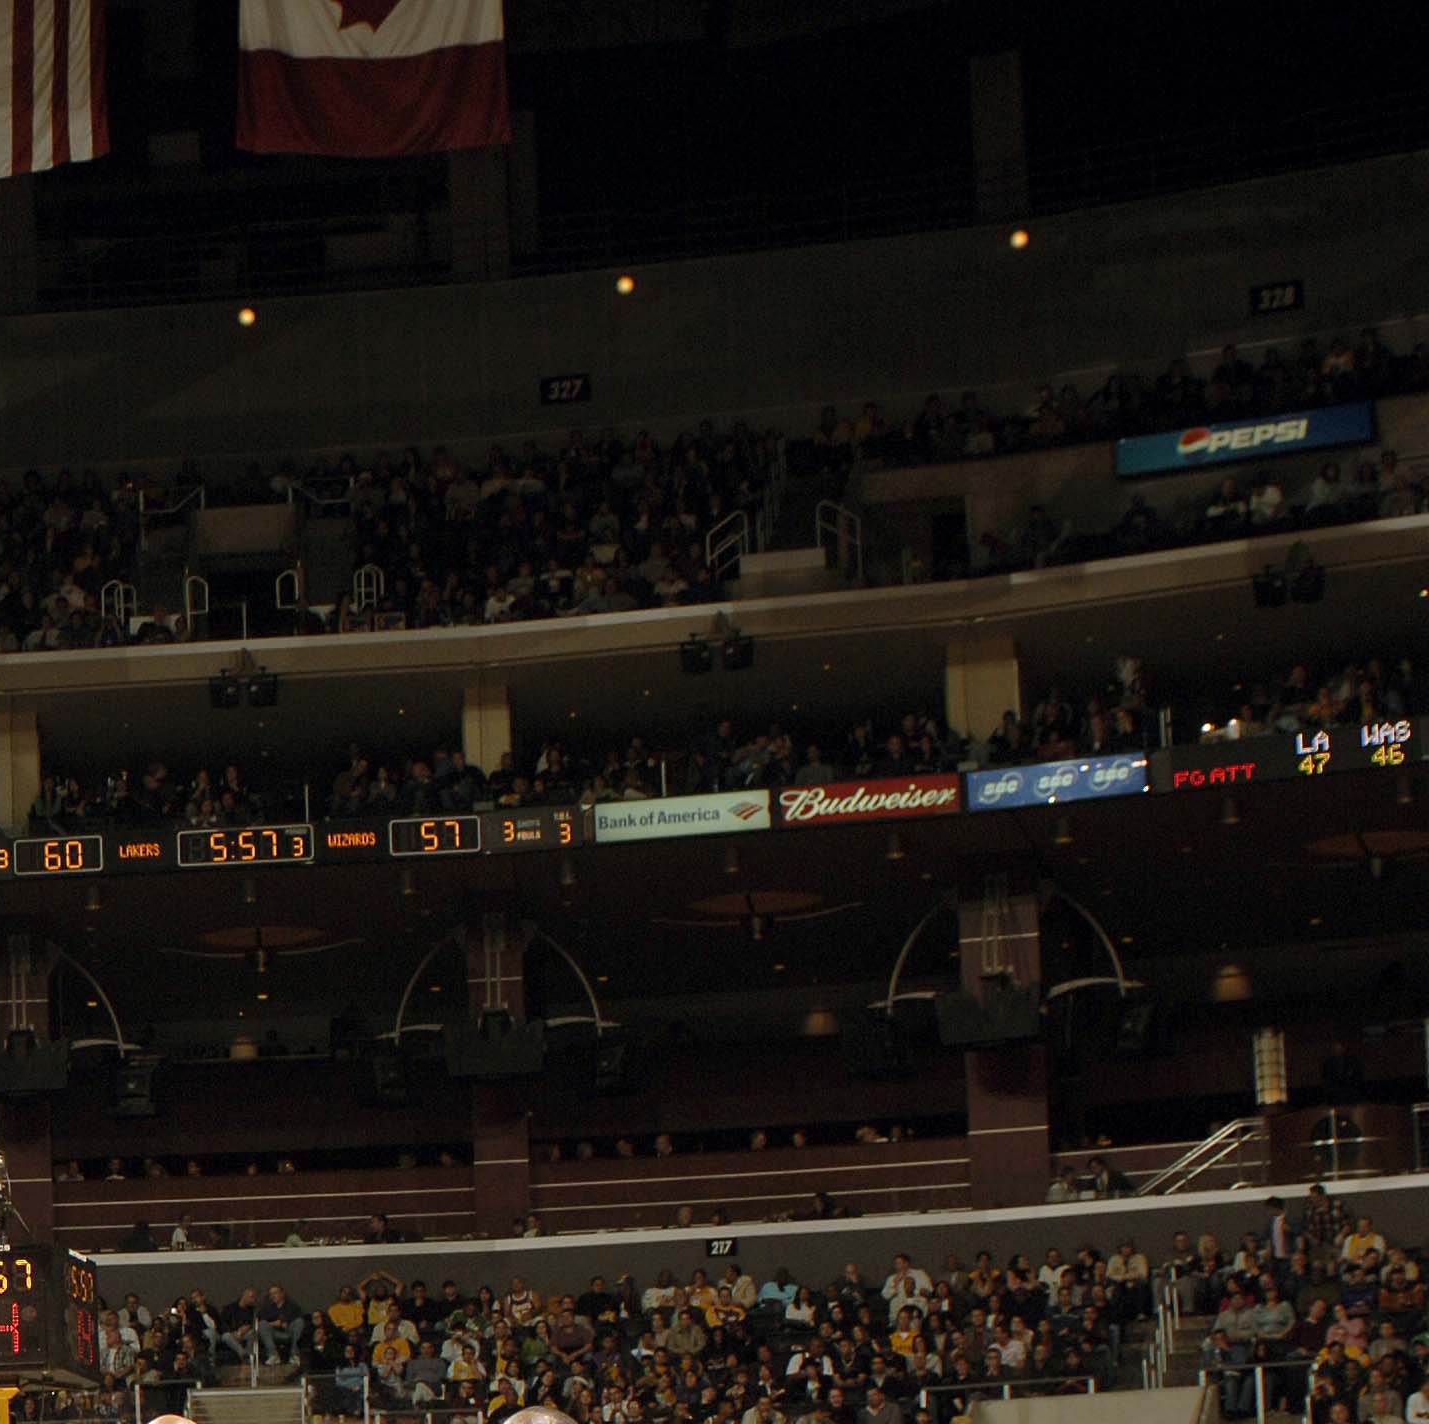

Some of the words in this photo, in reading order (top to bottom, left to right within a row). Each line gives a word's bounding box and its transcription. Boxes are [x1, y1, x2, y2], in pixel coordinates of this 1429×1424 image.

[1208, 418, 1308, 453] PEPSI
[1295, 730, 1330, 756] LA
[1361, 719, 1411, 748] WAS
[1298, 751, 1331, 775] 47
[1371, 743, 1405, 767] 46
[1174, 769, 1205, 790] FG
[1210, 763, 1257, 784] ATT
[779, 784, 956, 821] Budweiser
[504, 820, 515, 842] 3
[598, 813, 637, 831] Bank
[638, 811, 654, 827] of
[657, 807, 720, 826] America
[210, 830, 277, 862] 5:57
[293, 836, 304, 858] 3
[328, 832, 376, 849] WIZARDS
[421, 820, 459, 850] 57
[559, 822, 572, 845] 3
[44, 841, 84, 871] 60
[119, 843, 160, 858] LAKERS
[710, 1240, 732, 1256] 217
